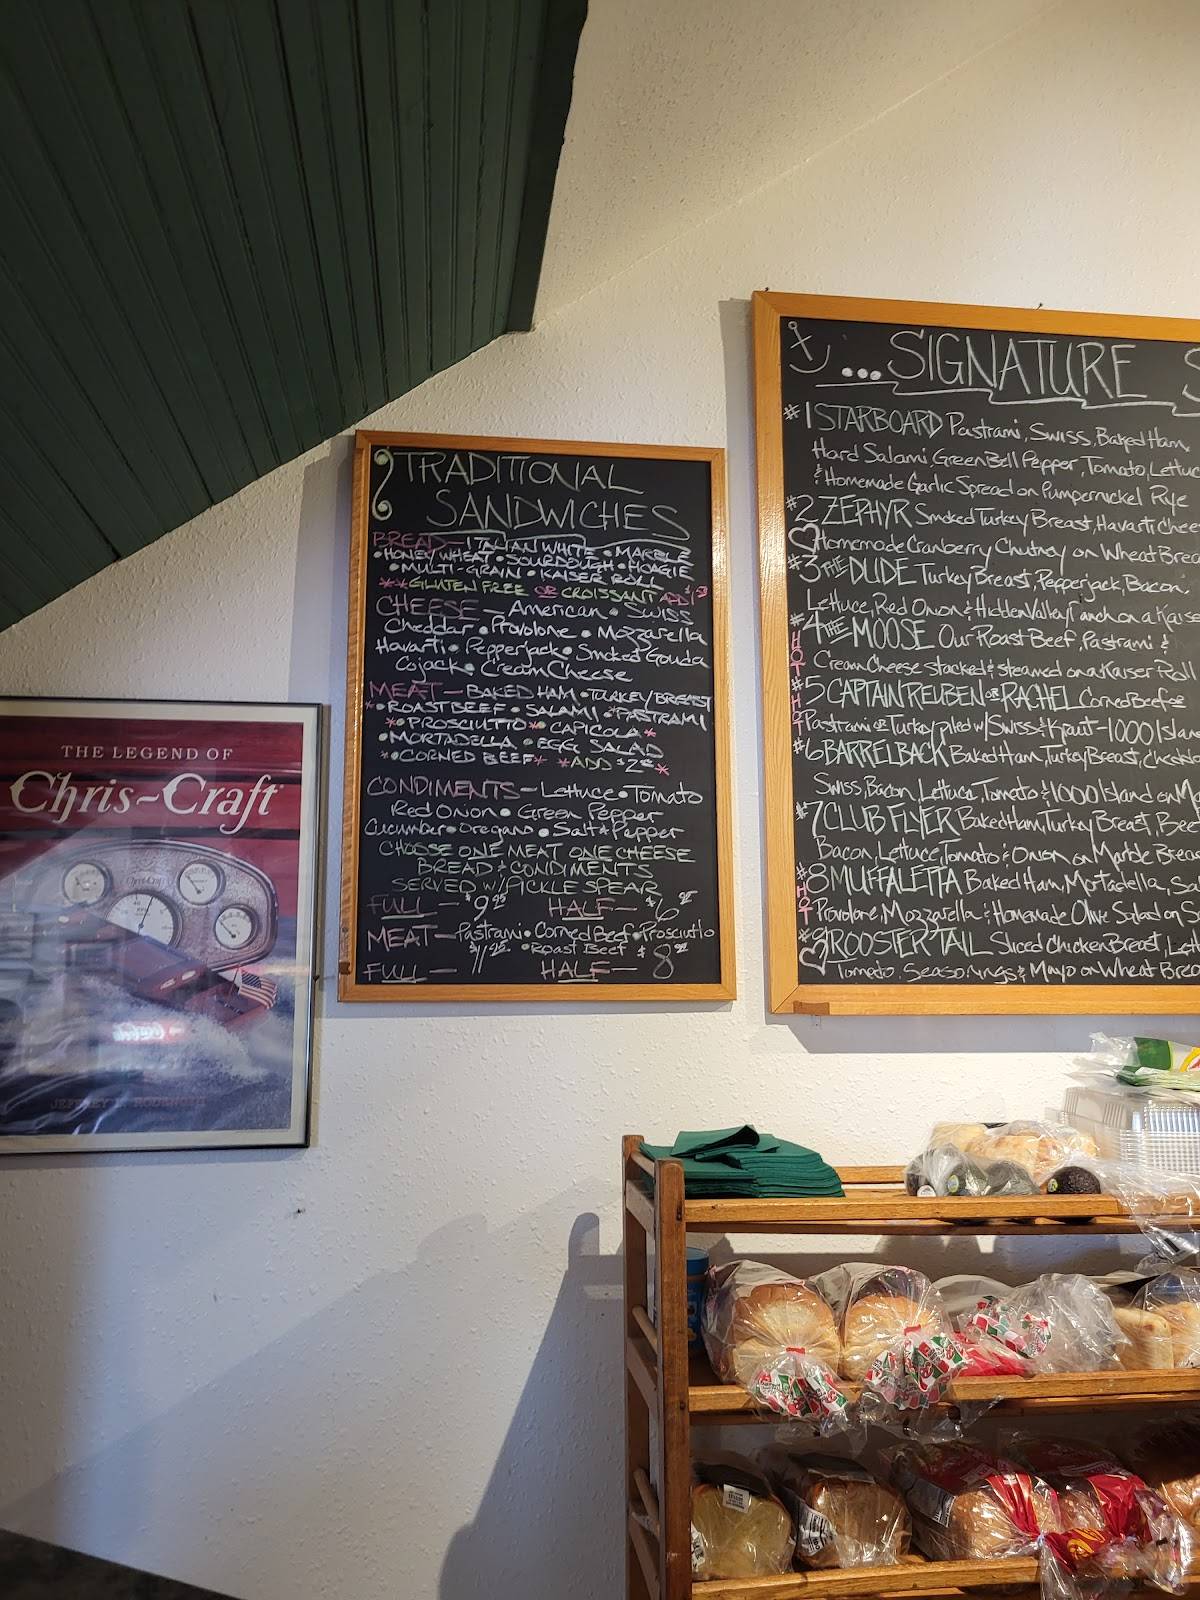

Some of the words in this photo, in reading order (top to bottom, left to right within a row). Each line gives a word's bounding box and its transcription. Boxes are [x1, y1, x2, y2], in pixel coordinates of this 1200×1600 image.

[887, 329, 1147, 399] SIGNATURE
[814, 403, 943, 438] STARBOARD
[1096, 427, 1145, 453] Baked
[812, 437, 858, 462] Hard
[932, 448, 986, 466] Green
[984, 450, 1018, 468] Bell
[393, 451, 643, 495] TRADITIONAL
[825, 466, 903, 491] Homemade
[907, 472, 952, 495] Garlic
[956, 475, 1013, 499] Spread
[1017, 487, 1038, 496] on
[1042, 481, 1142, 506] Pumpernickel
[1150, 485, 1188, 516] Rye
[427, 489, 690, 541] SANDWICHES
[818, 494, 913, 530] ZEPHYR
[915, 502, 975, 526] Smoked
[975, 507, 1029, 537] Turkey
[1096, 514, 1155, 535] Havarti
[372, 531, 447, 551] BREAD
[467, 536, 538, 554] ITALIAN
[542, 540, 595, 558] WHITE
[615, 547, 691, 566] MARBLE
[814, 529, 904, 554] Homemade
[907, 534, 992, 569] Cranberry
[995, 537, 1067, 576] Chutney
[1072, 546, 1099, 559] on
[1100, 542, 1157, 563] Wheat
[384, 550, 436, 566] HONEY
[439, 550, 491, 563] WHEAT
[505, 554, 614, 572] SOURDOUGH
[628, 561, 694, 581] HOAGIE
[401, 562, 522, 579] MULTI-GRAIN
[540, 568, 603, 585] KAISER
[610, 573, 664, 590] ROLL
[849, 556, 917, 585] DUDE
[913, 563, 971, 594] Turkey
[481, 581, 528, 596] FREE
[561, 586, 656, 604] CROISSANT
[872, 592, 907, 615] Red
[912, 598, 963, 616] Onion
[974, 593, 1028, 619] Hidden
[375, 596, 481, 621] CHEESE
[508, 597, 609, 620] American
[384, 615, 475, 636] Cheddar
[490, 613, 577, 639] Provolone
[597, 620, 708, 651] Mozzarella
[852, 617, 935, 650] MOOSE
[938, 624, 973, 648] Our
[970, 624, 1028, 648] Roast
[1082, 630, 1153, 651] Pastrami
[375, 639, 446, 657] Havarti
[465, 639, 567, 669] Pepperjack
[575, 642, 642, 663] Smoked
[646, 648, 710, 669] Gouda
[813, 650, 867, 671] Cream
[866, 653, 923, 674] Cheese
[1097, 661, 1154, 679] Kaiser
[1154, 659, 1197, 681] Roll
[395, 657, 467, 682] Cojack
[480, 658, 547, 679] Cream
[547, 662, 633, 683] Cheese
[369, 680, 443, 700] MEAT
[466, 684, 535, 700] BAKED
[537, 684, 578, 700] HAM
[588, 689, 654, 710] TURKEY
[653, 692, 712, 710] BREAST
[827, 677, 904, 709] CAPTAIN
[901, 679, 986, 710] REUBEN
[1000, 682, 1077, 713] RACHEL
[1079, 686, 1127, 709] Corned
[1127, 687, 1169, 712] Beef
[387, 701, 447, 714] ROAST
[451, 701, 507, 715] BEEF
[525, 703, 598, 720] SALAMI
[615, 709, 708, 732] PASTRAMI
[407, 716, 527, 731] PROSCIUTTO
[549, 721, 640, 737] CAPICOLA
[800, 708, 872, 733] Pastrami
[886, 714, 935, 753] Turkey
[939, 716, 971, 745] piled
[1047, 716, 1099, 745] Kraut
[61, 745, 104, 759] THE
[112, 747, 198, 761] LEGEND
[207, 748, 234, 761] OF
[389, 734, 518, 751] MORTADELLA
[537, 738, 582, 754] EGG
[589, 738, 665, 759] SALAD
[398, 749, 476, 764] CORNED
[483, 751, 535, 767] BEEF
[569, 755, 613, 770] ADD
[822, 739, 949, 768] BARRELBACK
[949, 745, 998, 765] Baked
[1040, 744, 1088, 772] Turkey
[367, 776, 521, 801] CONDIMENTS
[539, 781, 619, 802] Lettuce
[624, 782, 704, 805] Tomato
[971, 777, 1038, 801] Tomato
[1050, 781, 1098, 805] 1000
[1098, 778, 1153, 804] Island
[390, 800, 432, 817] Red
[436, 803, 500, 819] Onion
[516, 804, 583, 821] Green
[587, 802, 665, 828] Pepper
[824, 801, 886, 835] CLUB
[887, 802, 960, 840] FLYER
[954, 805, 1008, 832] Baked
[1037, 809, 1093, 845] Turkey
[364, 819, 447, 837] Cucumber
[459, 821, 534, 847] Oregano
[552, 820, 597, 838] Salt
[609, 820, 685, 842] Pepper
[378, 840, 453, 857] CHOOSE
[458, 842, 504, 860] ONE
[507, 843, 563, 858] MEAT
[568, 842, 612, 861] ONE
[614, 844, 696, 863] CHEESE
[938, 838, 999, 865] Tomato
[1012, 846, 1071, 865] Onion
[416, 859, 493, 876] BREAD
[510, 860, 654, 878] CONDIMENTS
[830, 863, 962, 899] MUFFALETTA
[963, 868, 1021, 892] Baked
[391, 876, 477, 895] SERVED
[584, 880, 662, 896] SPEAR
[367, 894, 437, 917] FULL
[548, 897, 615, 919] HALF
[882, 899, 982, 940] Mozzarella
[993, 899, 1071, 927] Homemade
[1112, 900, 1160, 925] Salad
[367, 924, 437, 952] MEAT
[455, 922, 524, 943] Pastrami
[534, 923, 592, 943] Corned
[592, 923, 634, 944] Beef
[639, 925, 715, 942] Prosciutto
[530, 941, 577, 956] Roast
[583, 942, 626, 957] Beef
[830, 927, 931, 959] ROOSTER
[929, 927, 994, 957] TAIL
[990, 931, 1043, 955] Sliced
[1046, 934, 1110, 952] Chicken
[363, 961, 427, 982] FULL
[540, 960, 610, 982] HALF
[1030, 960, 1076, 983] Mayo
[1098, 956, 1158, 978] Wheat
